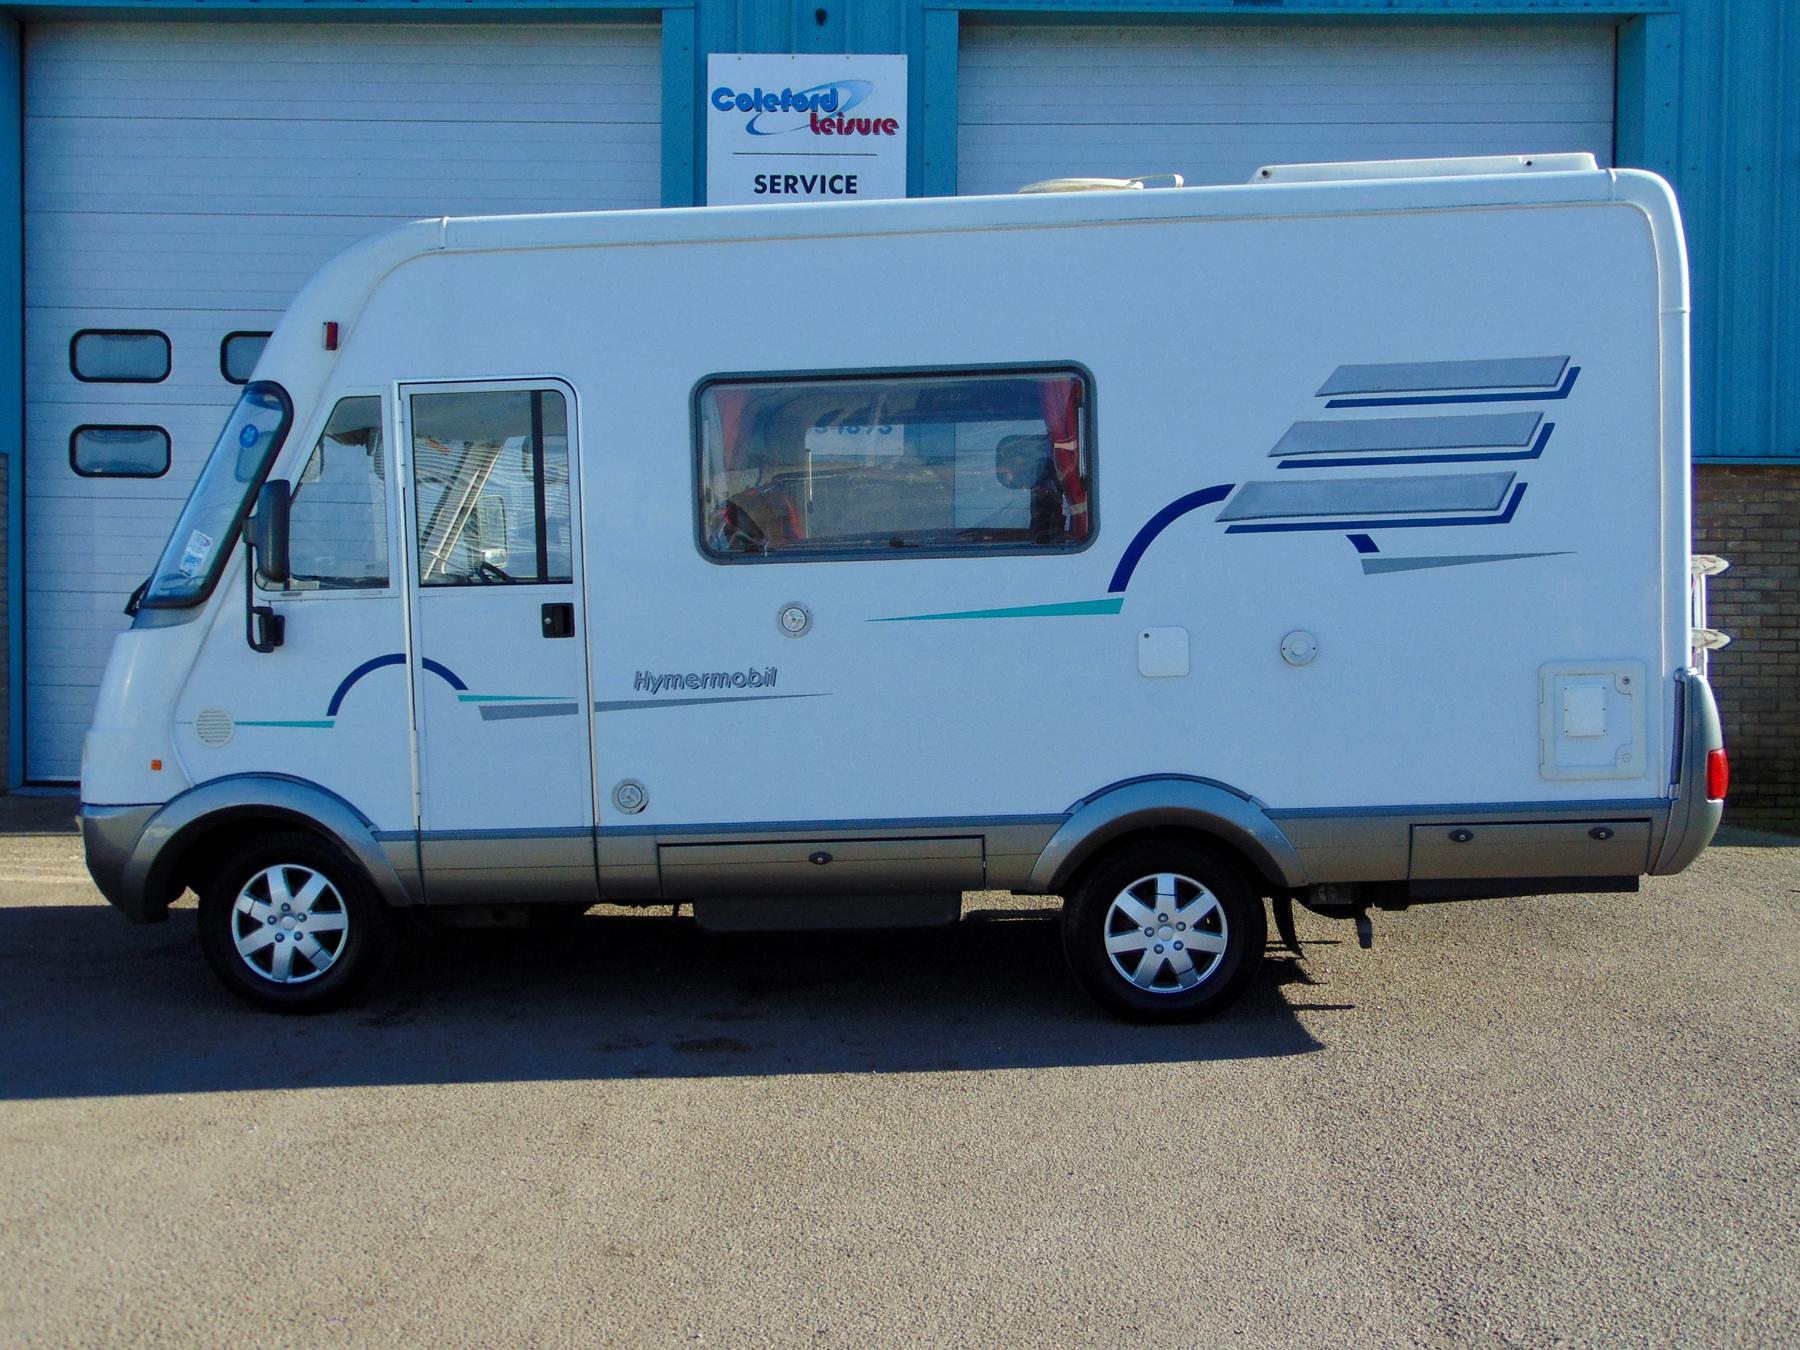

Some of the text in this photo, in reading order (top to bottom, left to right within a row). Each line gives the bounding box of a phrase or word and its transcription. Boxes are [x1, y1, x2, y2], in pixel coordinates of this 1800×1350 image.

[711, 87, 838, 112] Coleford
[754, 174, 857, 194] SERVICE
[633, 666, 778, 695] Hymermobil
